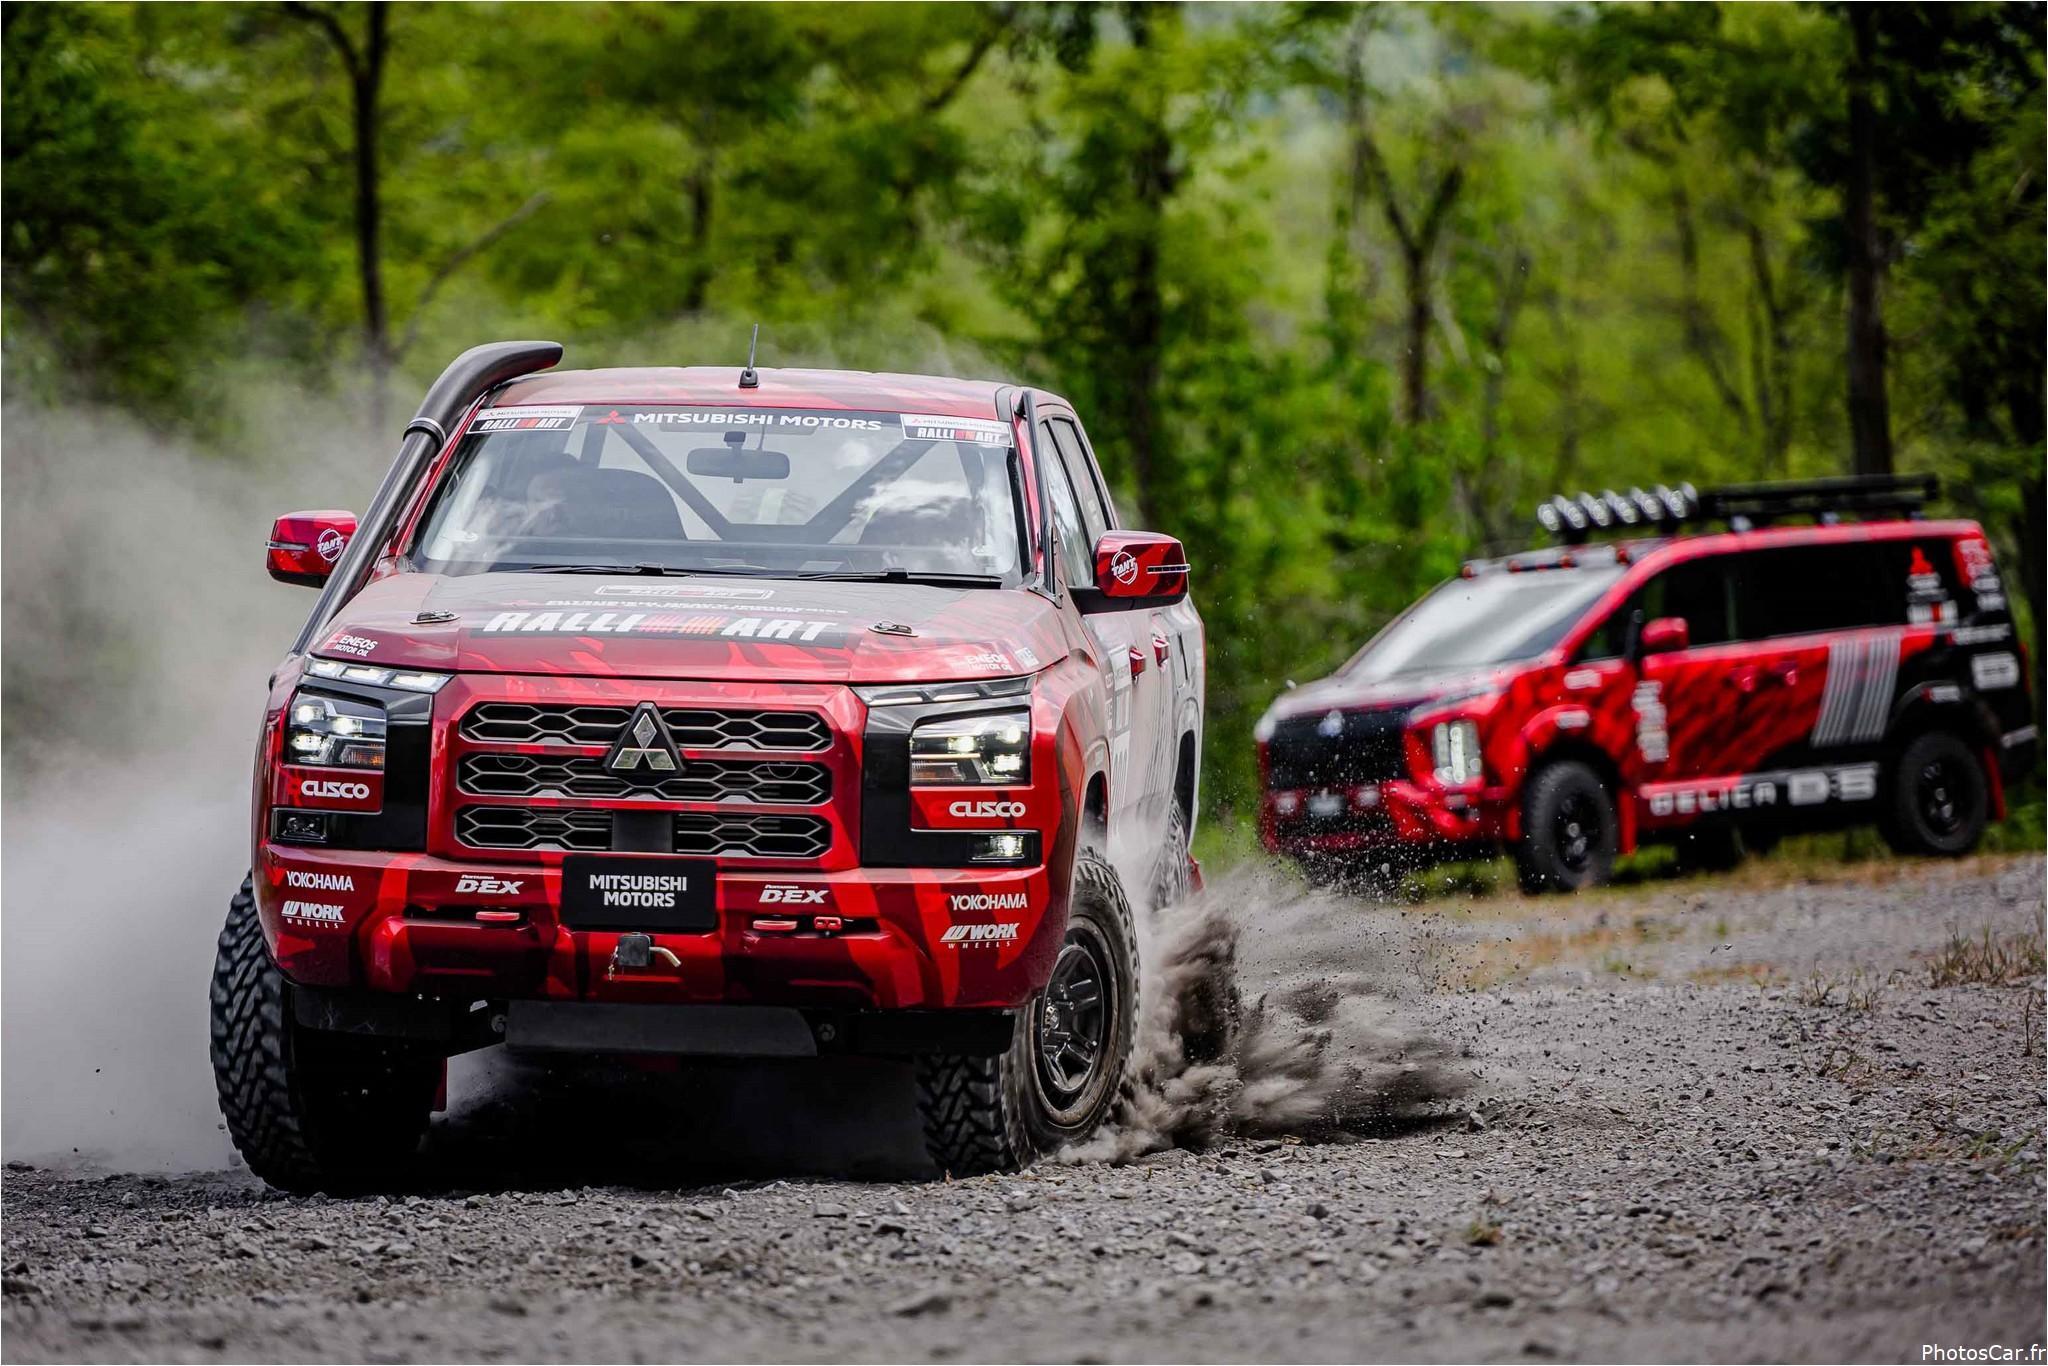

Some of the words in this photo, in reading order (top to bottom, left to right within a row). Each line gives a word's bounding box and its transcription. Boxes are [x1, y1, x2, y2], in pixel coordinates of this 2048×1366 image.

[633, 413, 772, 426] MITSUBISHI
[780, 415, 882, 431] MOTORS
[334, 643, 358, 654] MOTOR
[357, 649, 369, 657] OIL
[339, 635, 378, 650] ENEOS
[301, 780, 370, 799] CUSCO
[949, 801, 1026, 818] CUSCO
[286, 870, 354, 892] YOKOHAMA
[455, 879, 524, 894] DEX
[589, 874, 687, 891] MITSUBISHI
[603, 891, 675, 908] MOTORS
[758, 889, 829, 903] DEX
[951, 893, 1028, 911] YOKOHAMA
[948, 941, 1011, 949] WHEELS
